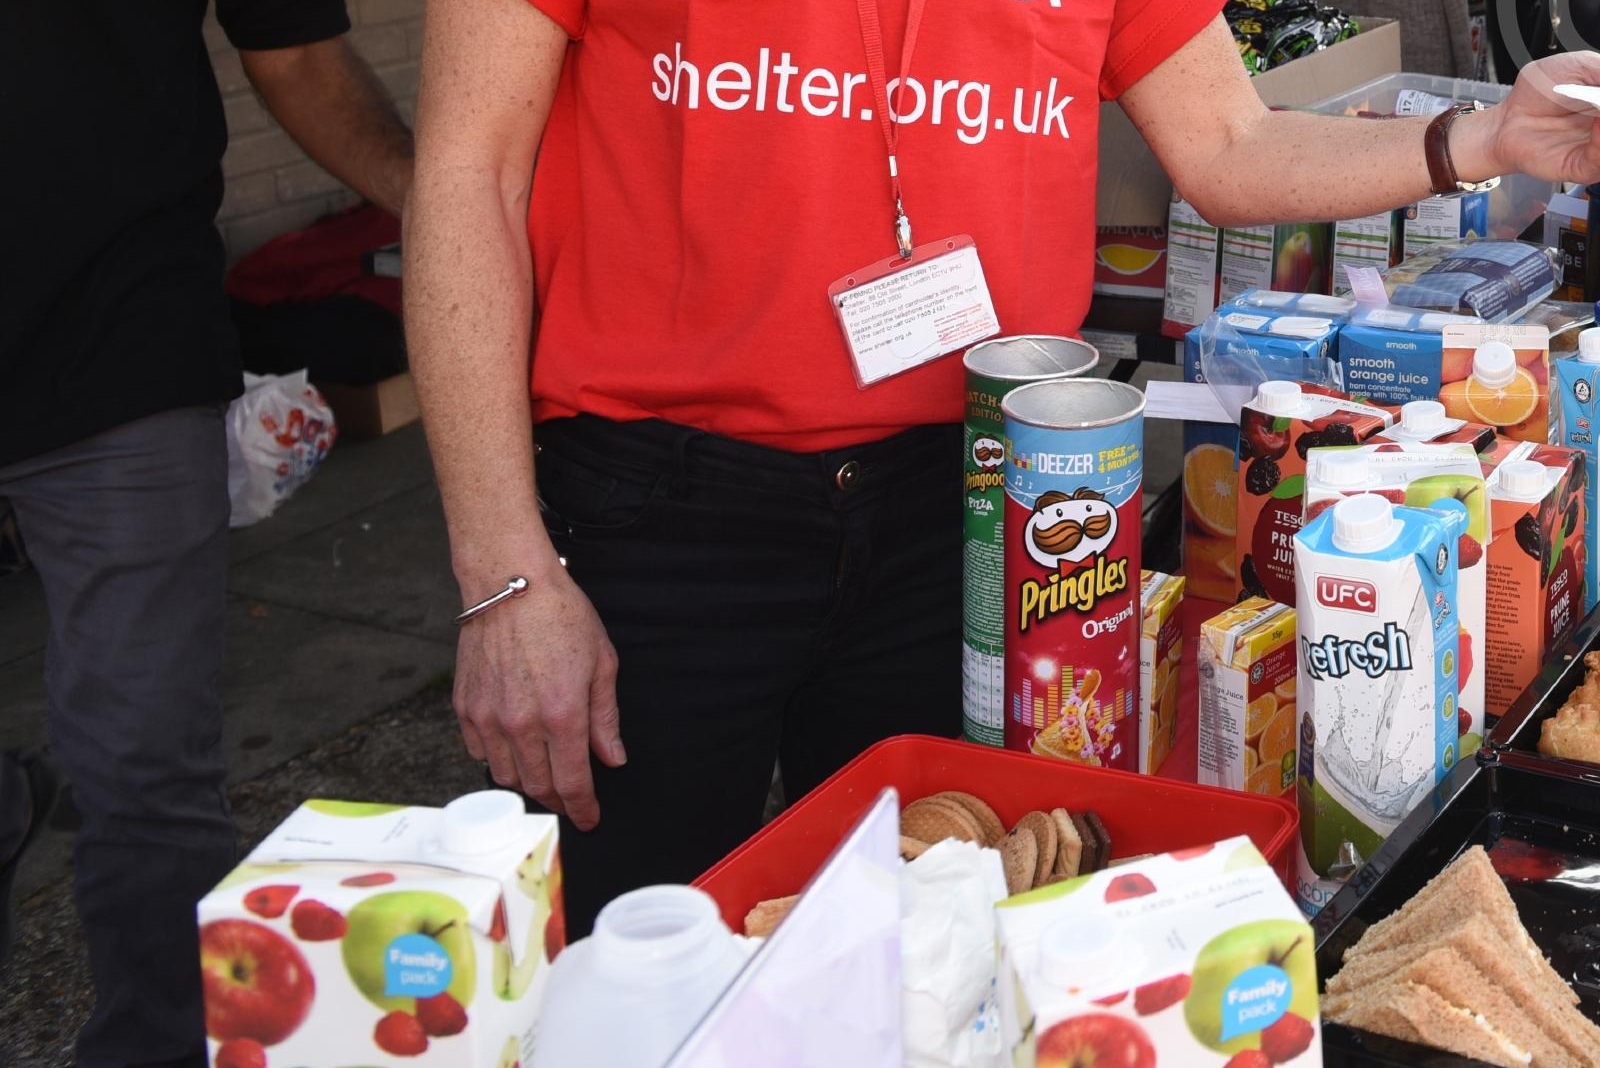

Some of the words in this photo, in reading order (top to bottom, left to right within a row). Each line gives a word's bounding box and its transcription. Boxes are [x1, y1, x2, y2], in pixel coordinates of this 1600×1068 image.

[651, 42, 1074, 144] shelter.org.uk
[1386, 341, 1417, 350] smooth
[1349, 357, 1395, 369] smooth
[1349, 370, 1395, 383] orange
[1398, 372, 1429, 384] juice
[1367, 384, 1411, 393] concentrate
[1373, 391, 1387, 399] with
[1390, 392, 1409, 400] 100%
[971, 407, 1003, 421] EDITIO
[1038, 452, 1093, 475] DEEZER
[1099, 446, 1126, 461] FREE
[1098, 462, 1105, 474] 4
[968, 497, 994, 510] PIZZA
[1275, 510, 1304, 526] TESC
[1272, 531, 1295, 549] PRU
[1273, 548, 1295, 565] JUI
[1550, 568, 1568, 594] TESCO
[1020, 556, 1127, 630] Pringles
[1322, 582, 1373, 607] UFC
[1550, 590, 1570, 624] PRUNE
[1082, 600, 1134, 639] Original
[1552, 609, 1570, 638] JUICE
[1226, 689, 1244, 701] Juice
[390, 948, 449, 972] Family
[400, 971, 438, 986] pack
[1228, 979, 1288, 1006] Family
[1239, 998, 1277, 1024] pack
